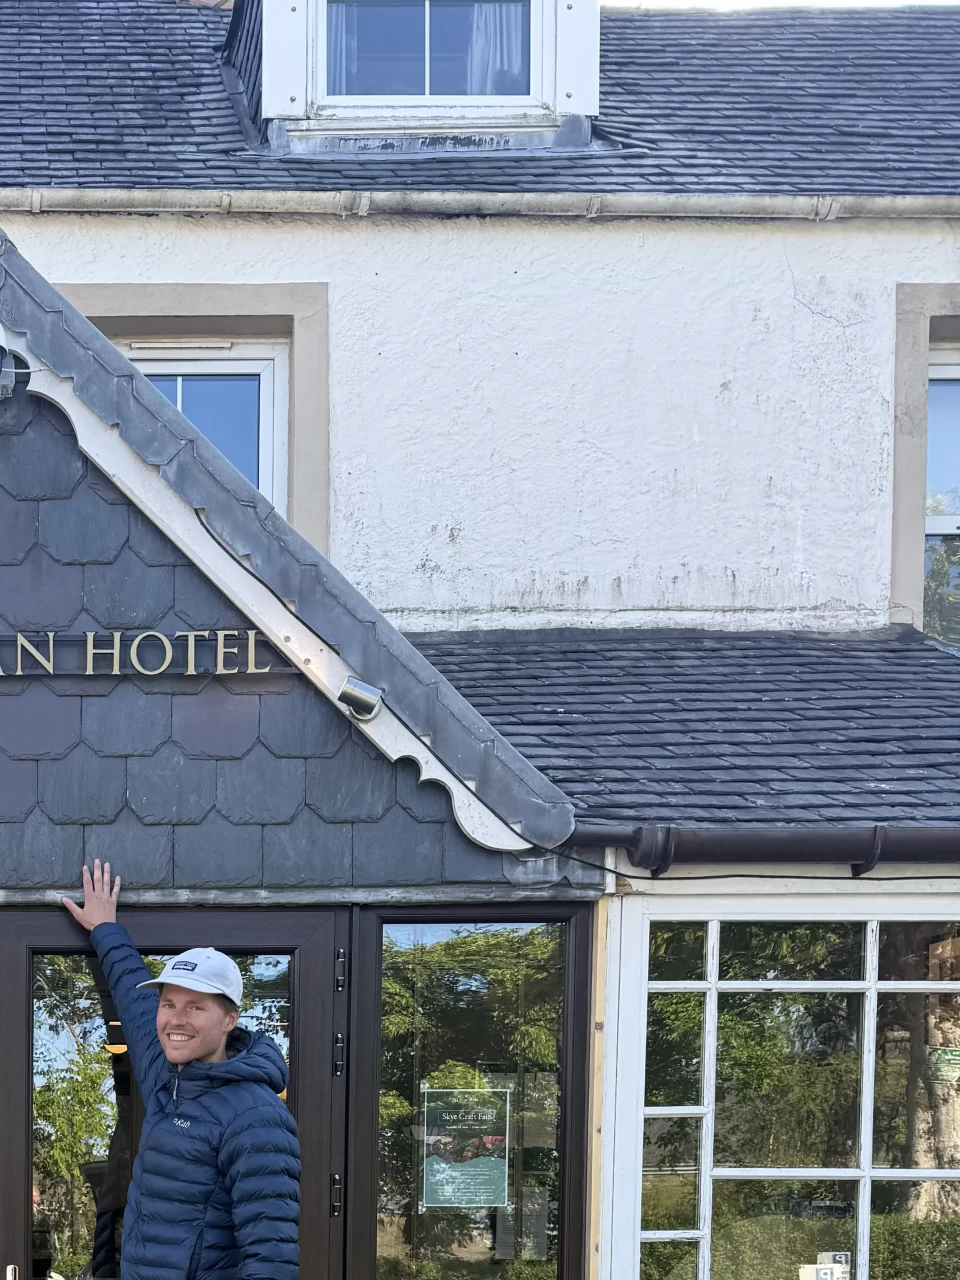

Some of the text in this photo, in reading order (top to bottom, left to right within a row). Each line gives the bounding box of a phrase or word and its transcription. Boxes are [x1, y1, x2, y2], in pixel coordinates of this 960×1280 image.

[84, 629, 272, 676] HOTEL
[442, 1112, 458, 1121] Skye
[459, 1112, 477, 1120] Craft
[175, 1118, 191, 1129] Rab
